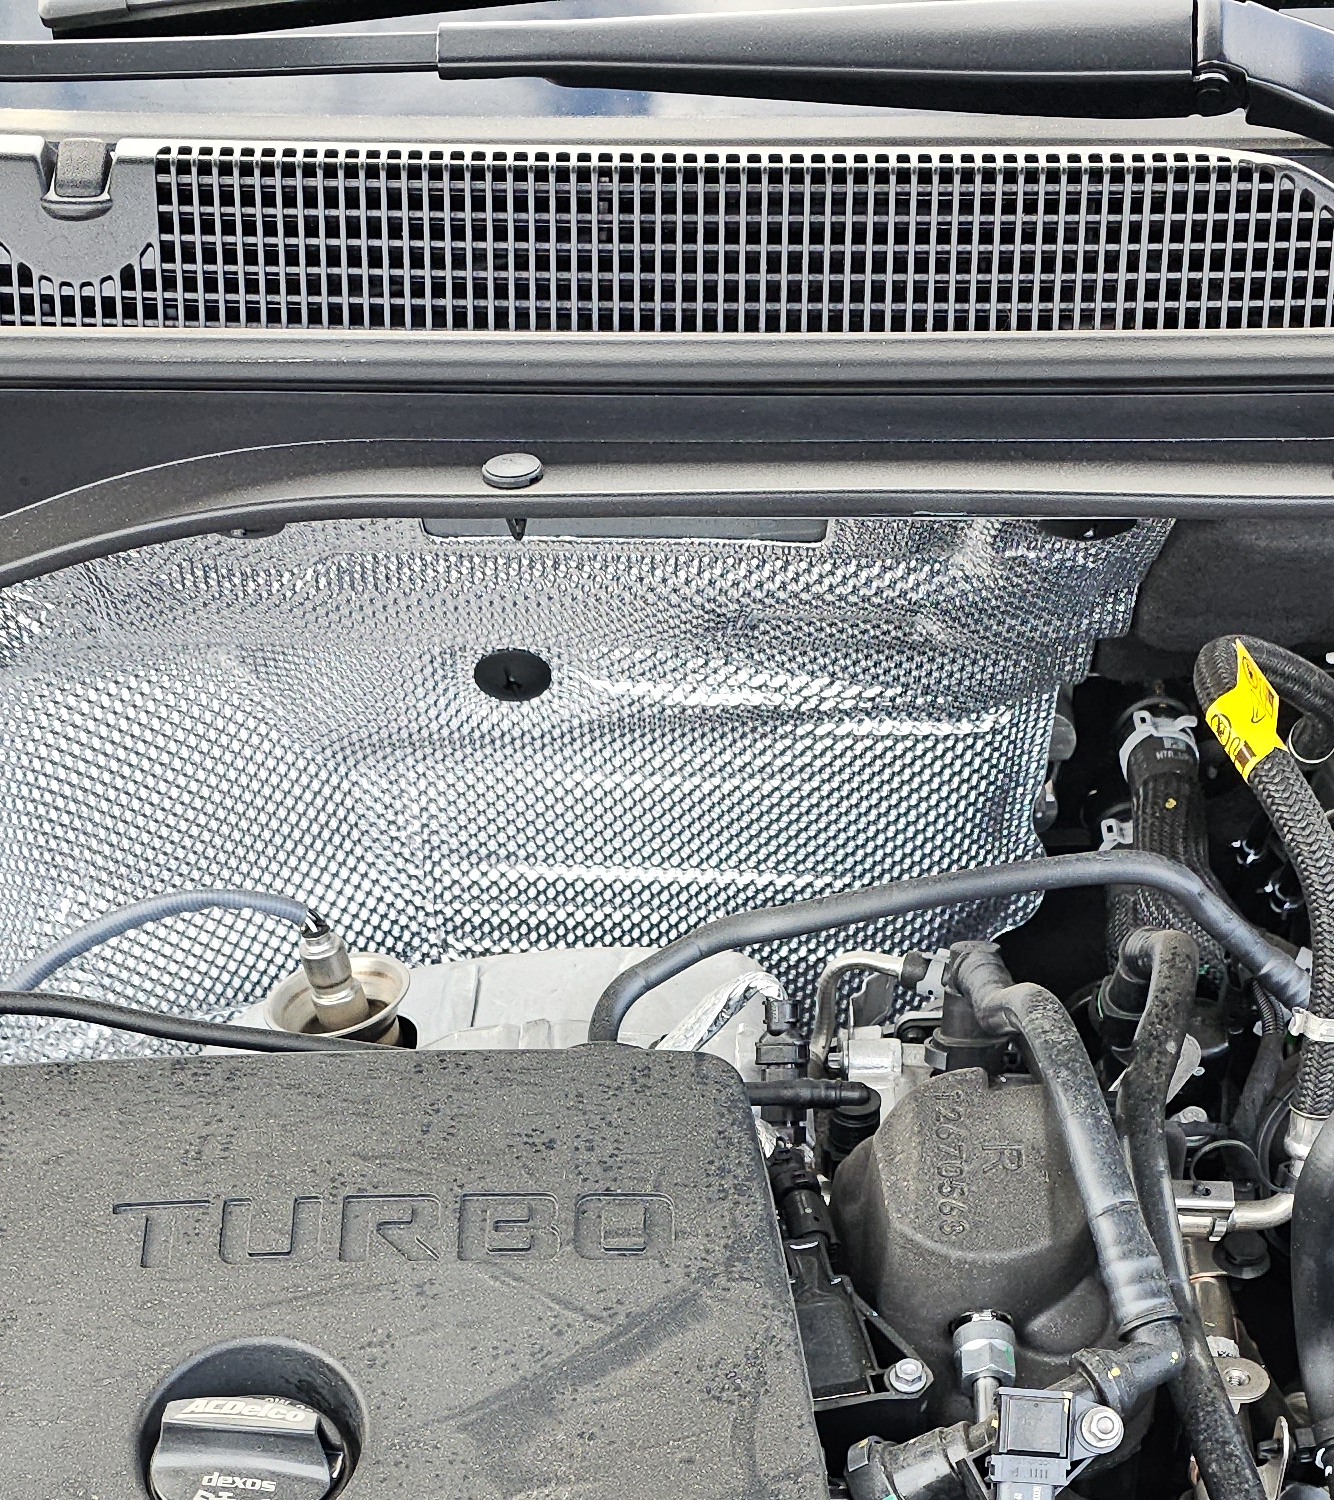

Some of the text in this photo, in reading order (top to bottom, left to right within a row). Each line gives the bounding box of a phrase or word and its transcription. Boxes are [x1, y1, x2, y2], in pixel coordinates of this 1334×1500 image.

[982, 1143, 1025, 1174] R
[113, 1191, 676, 1269] TURBO
[183, 1400, 306, 1422] ACDelco
[201, 1472, 277, 1492] dexos
